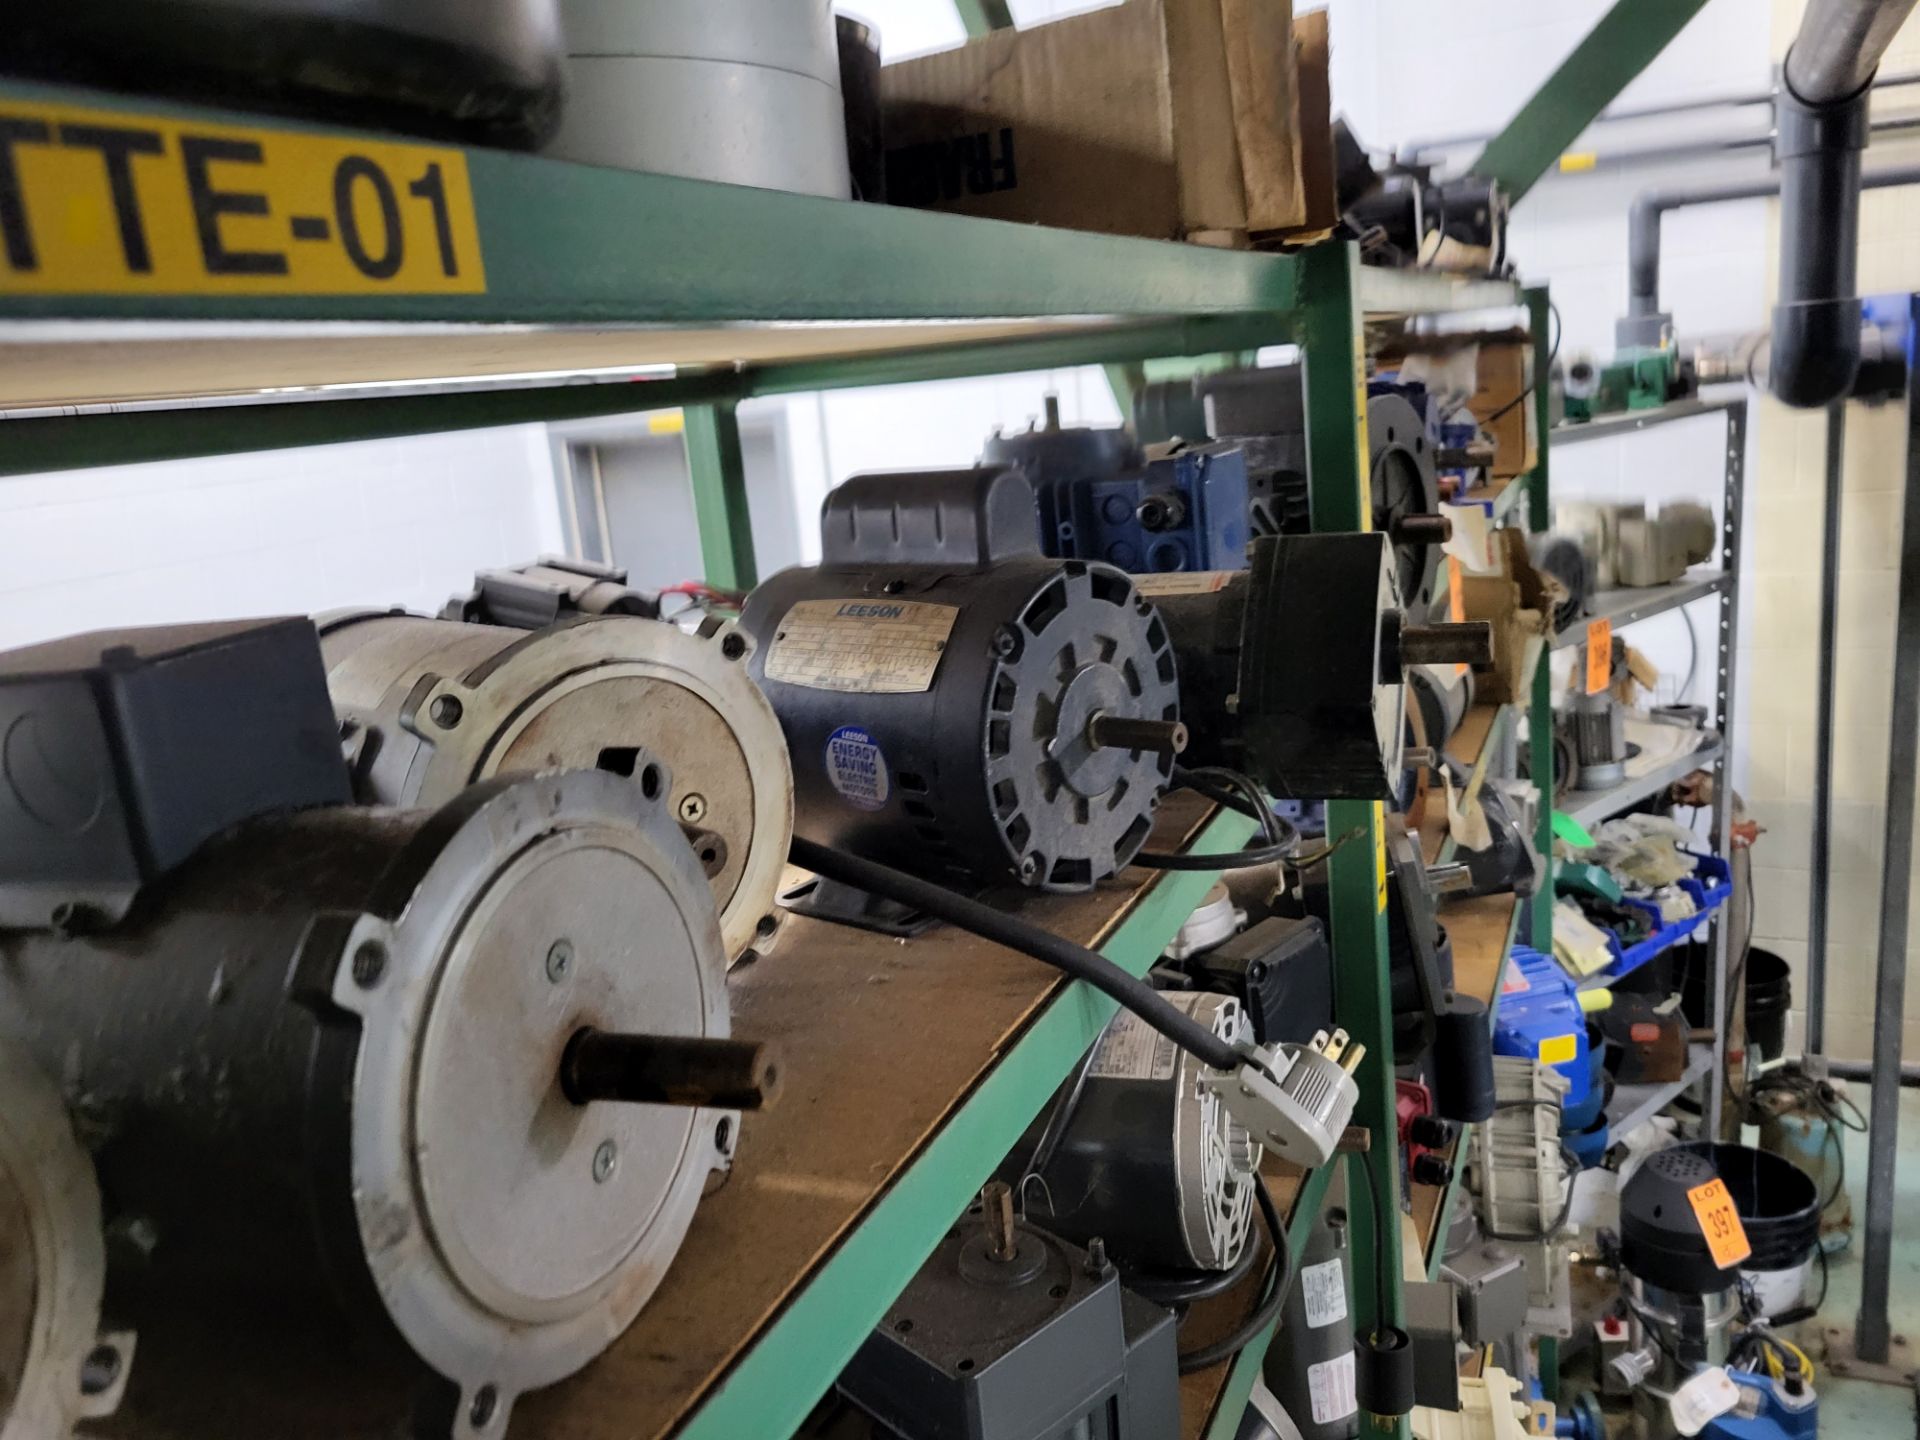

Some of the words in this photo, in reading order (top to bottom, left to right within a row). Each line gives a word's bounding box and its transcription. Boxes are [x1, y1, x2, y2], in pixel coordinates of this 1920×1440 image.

[836, 603, 904, 618] LEESON
[841, 730, 869, 743] LEESON
[832, 740, 877, 762] ENERGY
[834, 754, 877, 775] SAVING
[838, 769, 877, 785] ELECTRIC
[842, 782, 878, 798] MOTORS
[1694, 1182, 1721, 1202] LOT
[1708, 1205, 1735, 1238] 397
